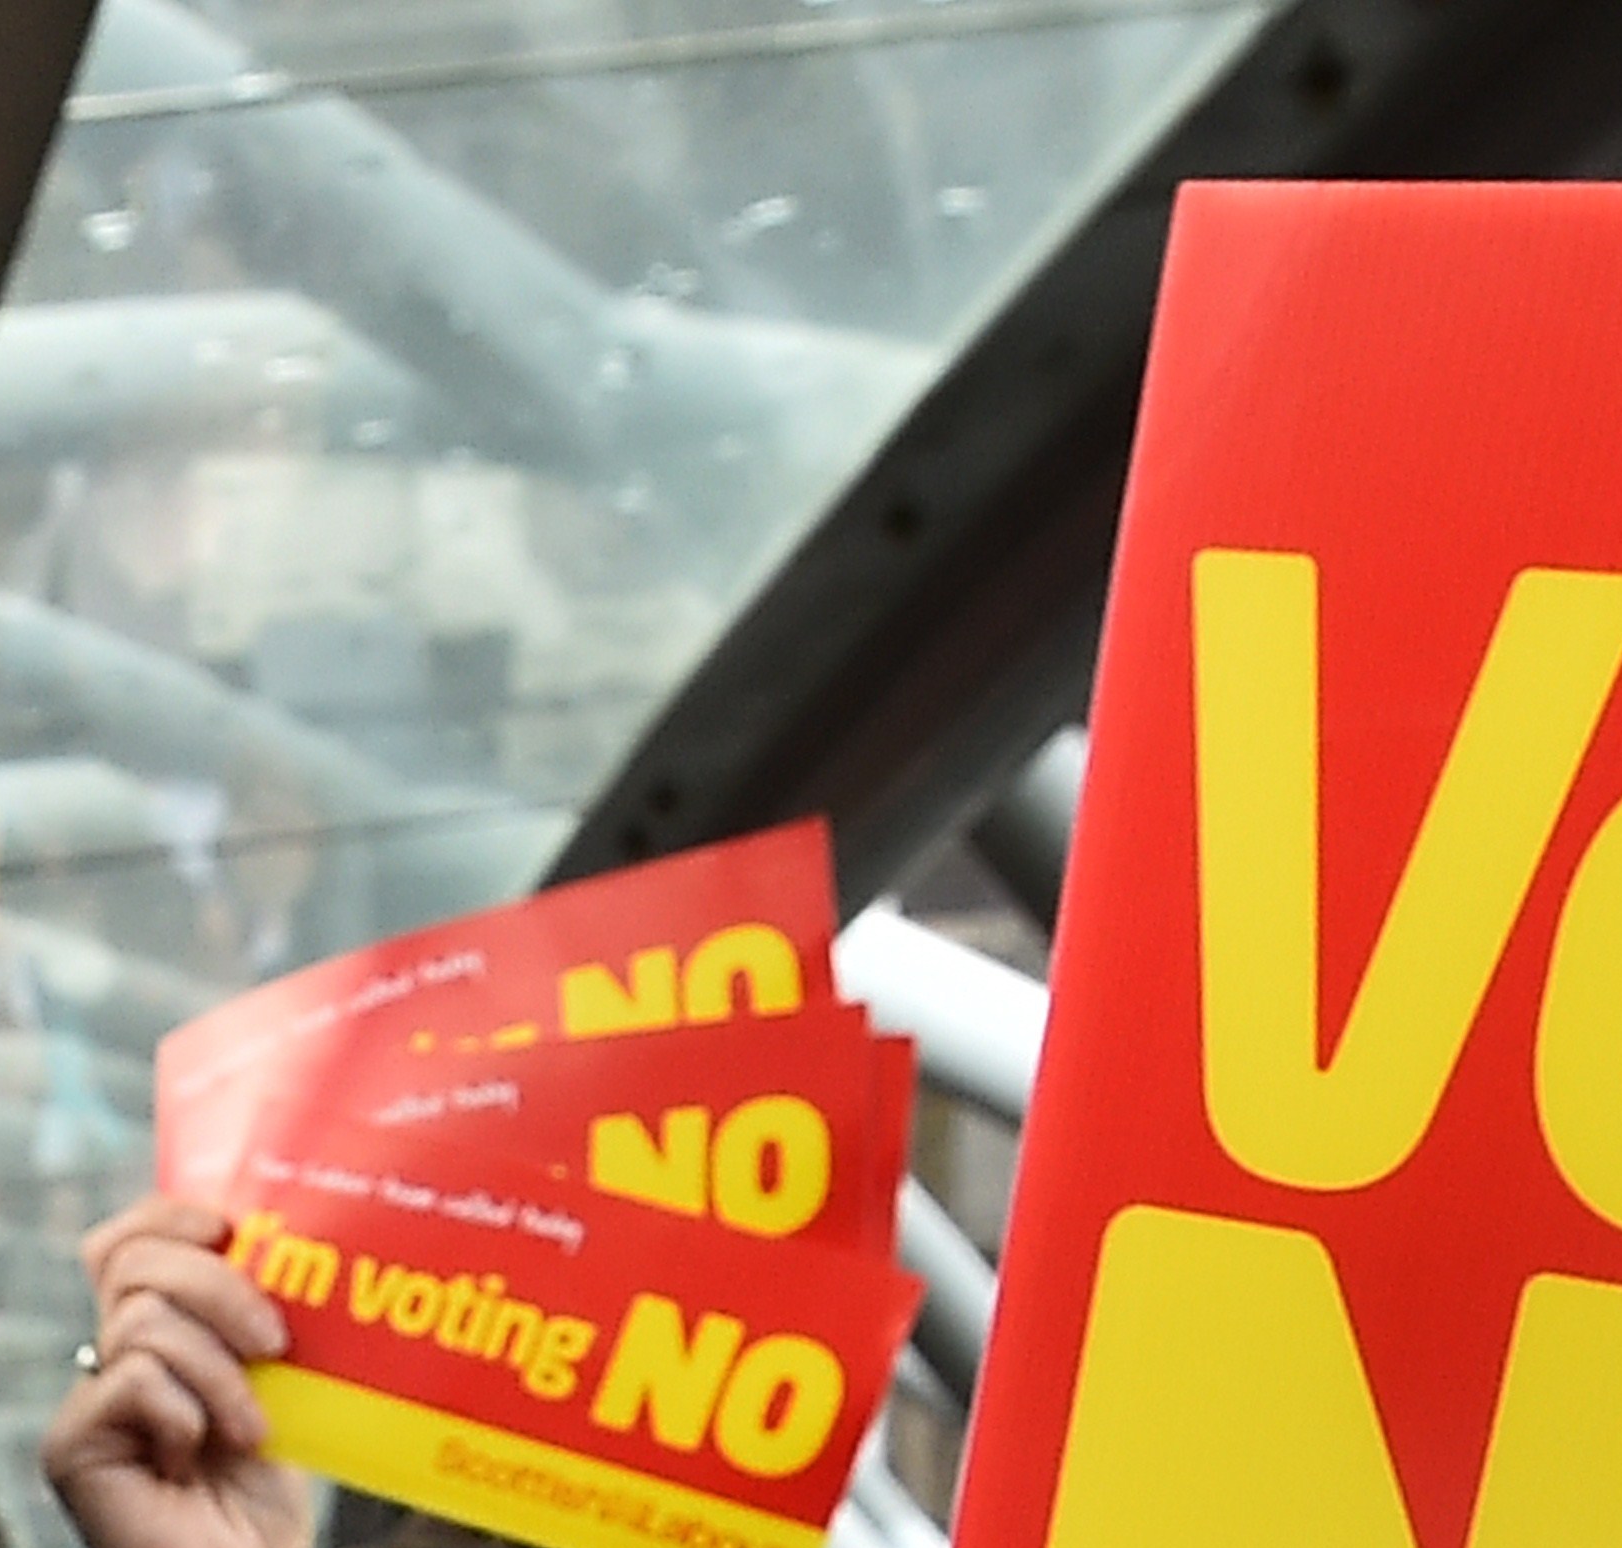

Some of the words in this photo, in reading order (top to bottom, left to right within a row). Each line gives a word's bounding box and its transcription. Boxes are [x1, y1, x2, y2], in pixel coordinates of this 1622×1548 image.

[587, 1094, 832, 1240] NO
[349, 1254, 600, 1400] voting
[589, 1291, 845, 1478] NO
